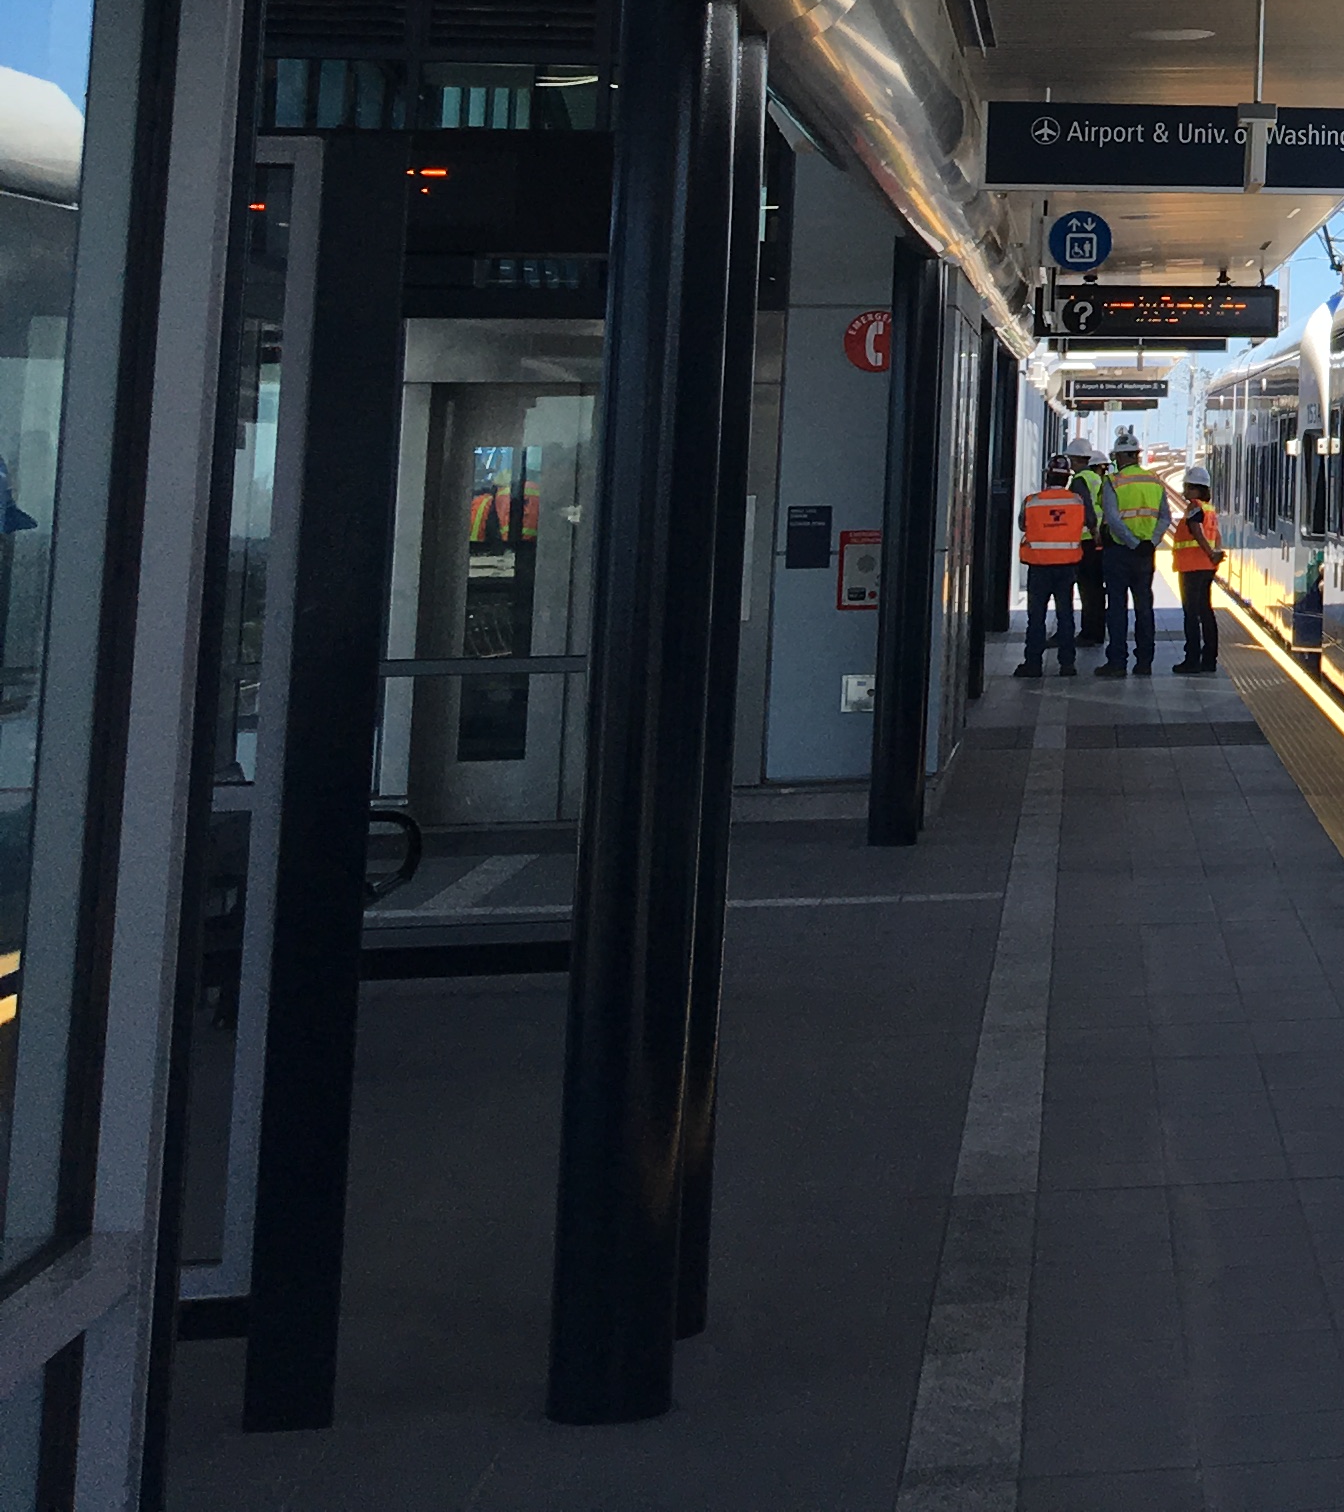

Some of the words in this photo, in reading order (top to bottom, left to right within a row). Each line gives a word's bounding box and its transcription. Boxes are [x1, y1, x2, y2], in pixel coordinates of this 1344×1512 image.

[1067, 121, 1145, 147] Airport
[1153, 122, 1169, 143] &
[1178, 122, 1229, 144] Univ.
[1234, 128, 1247, 145] o
